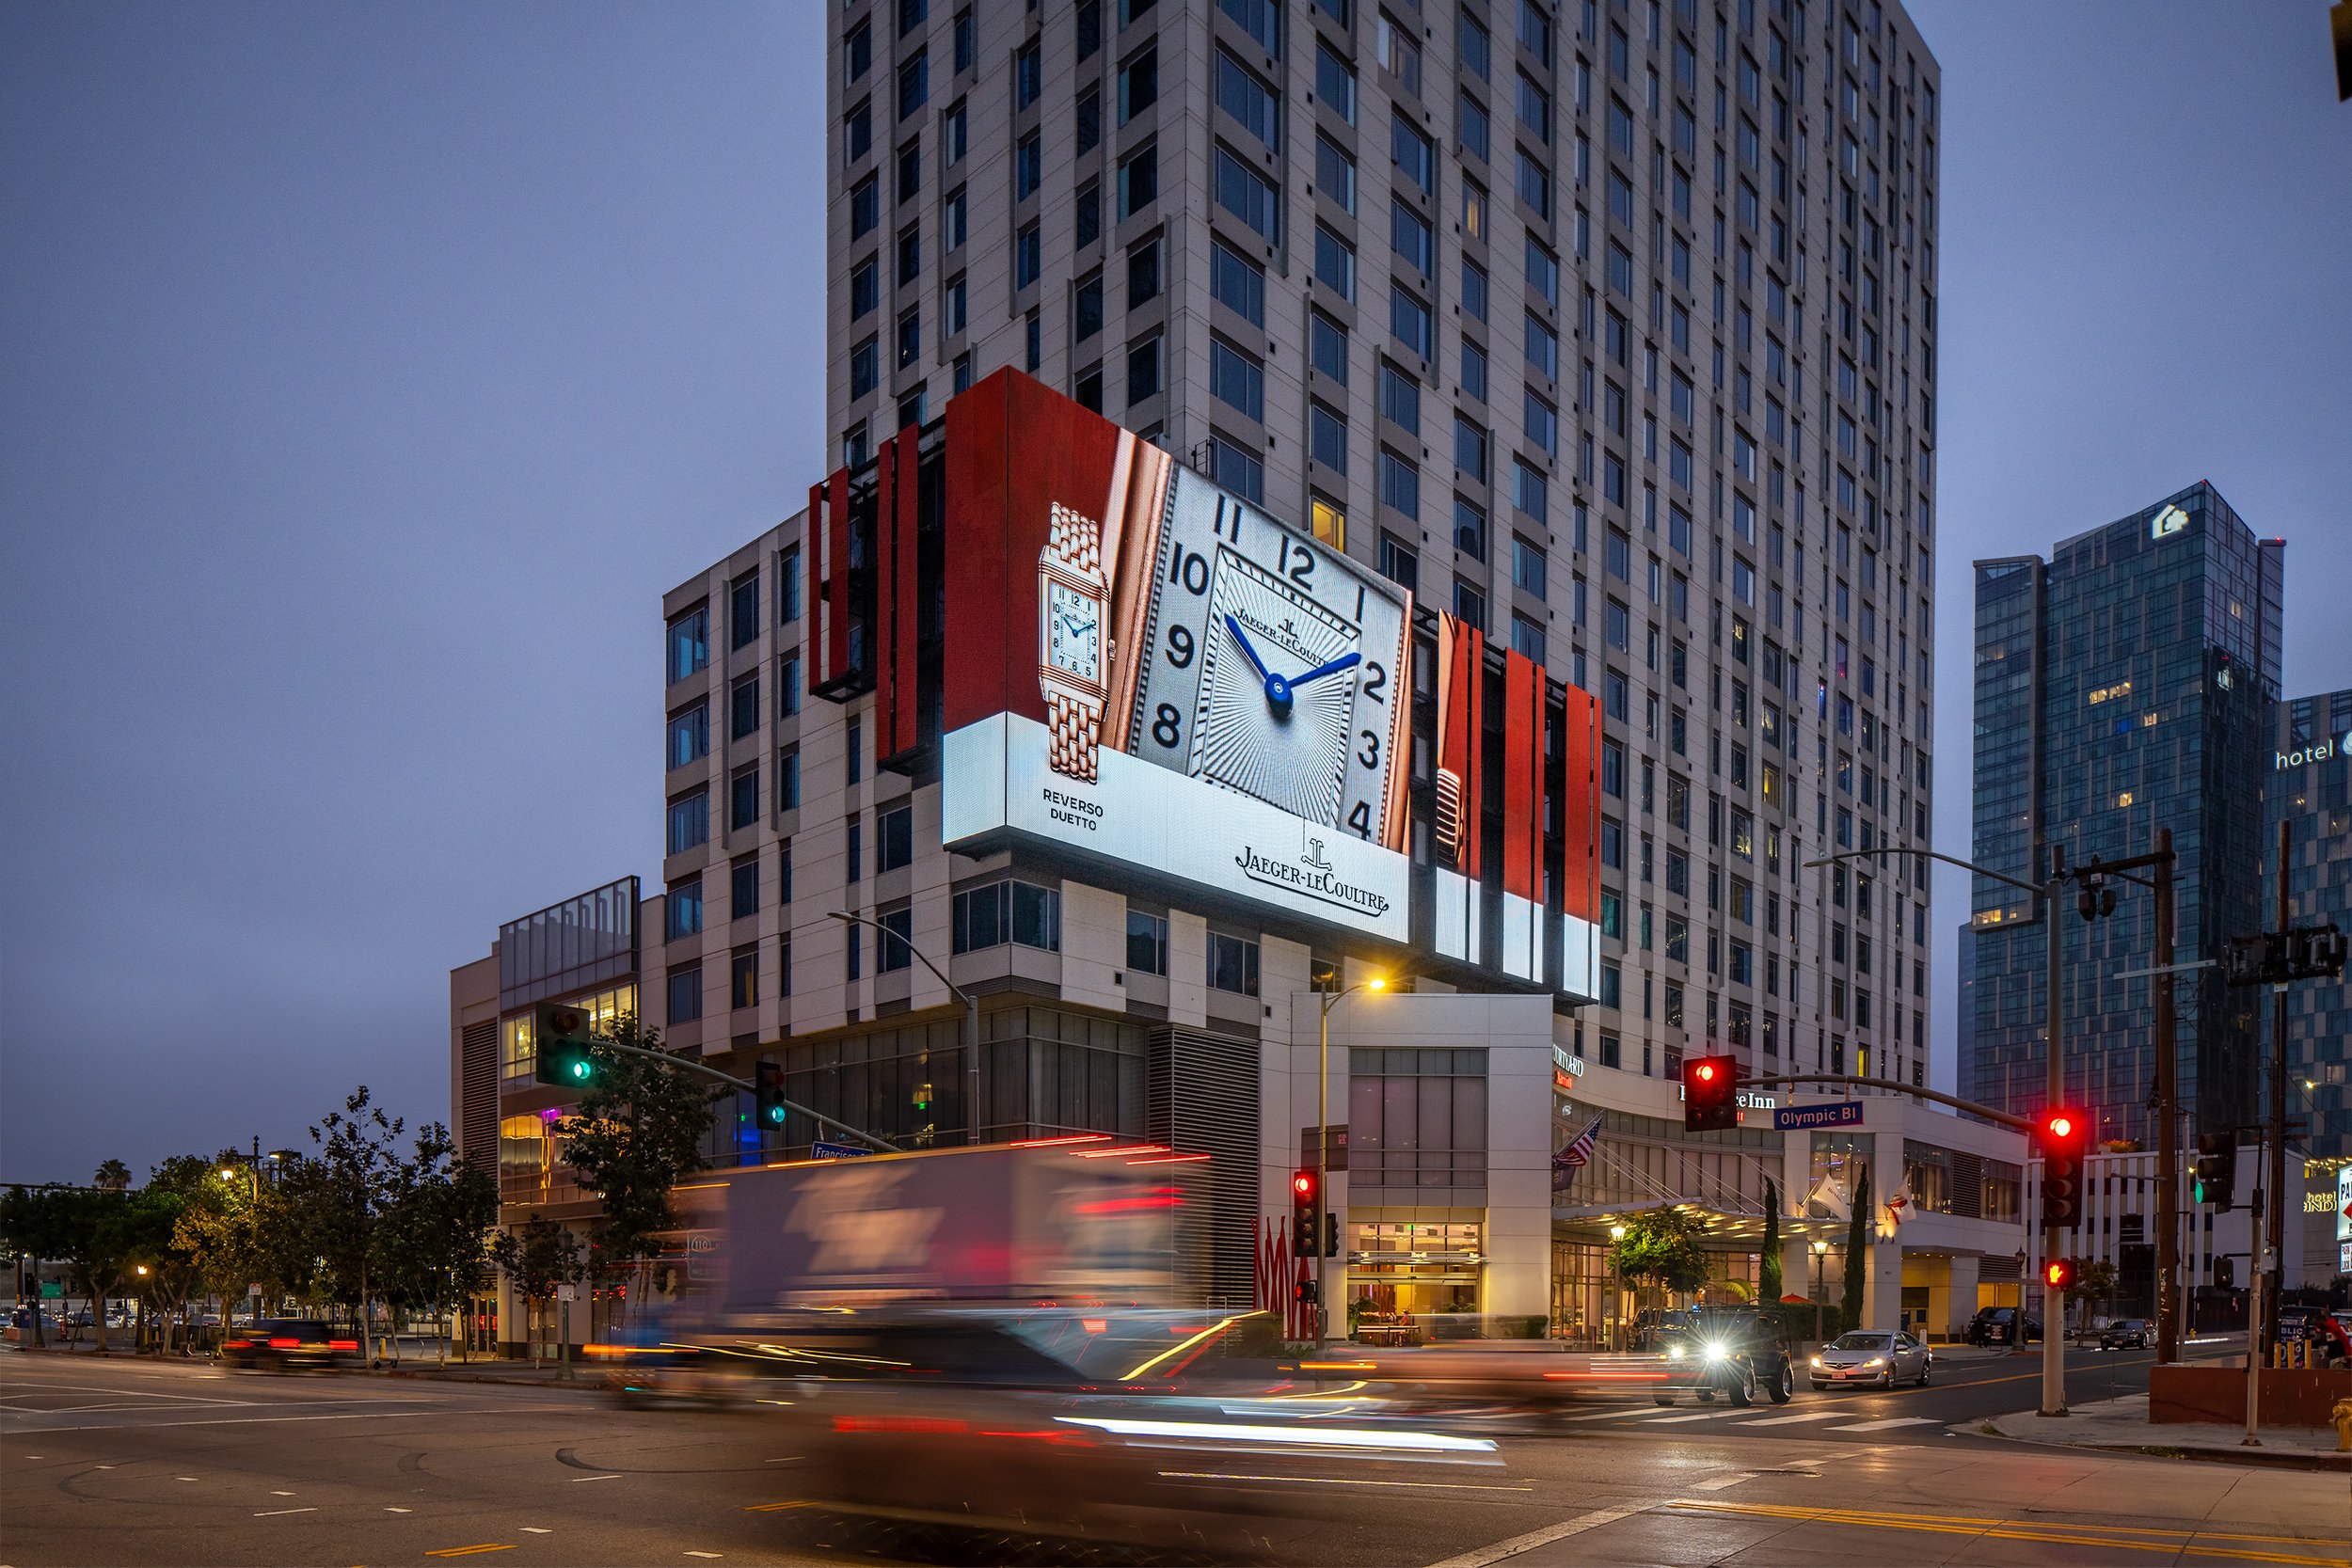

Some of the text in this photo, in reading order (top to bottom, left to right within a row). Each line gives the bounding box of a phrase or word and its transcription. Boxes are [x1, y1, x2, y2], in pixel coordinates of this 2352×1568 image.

[1214, 493, 1243, 545] 11
[1169, 541, 1209, 595] 10
[1278, 533, 1314, 592] 12
[1053, 602, 1060, 613] 10
[1072, 594, 1080, 607] 12
[1354, 584, 1365, 623] 1
[1054, 620, 1059, 630] 9
[1054, 639, 1059, 648] 8
[1091, 637, 1097, 646] 3
[1166, 624, 1195, 669] 9
[1233, 609, 1328, 667] JAEGER-LECOULT
[1059, 655, 1064, 666] 7
[1073, 661, 1078, 672] 6
[1091, 653, 1097, 664] 4
[1086, 666, 1091, 676] 5
[1364, 660, 1387, 705] 2
[1152, 703, 1181, 749] 8
[1358, 730, 1380, 770] 3
[2276, 738, 2333, 769] hotel
[1042, 788, 1104, 817] REVERSO
[1051, 808, 1097, 831] DUETTO
[1348, 800, 1372, 841] 4
[1747, 1092, 1776, 1109] Inn
[1781, 1107, 1856, 1127] Olympic Bl
[2306, 1191, 2337, 1202] hotel
[2341, 1181, 2352, 1201] PA
